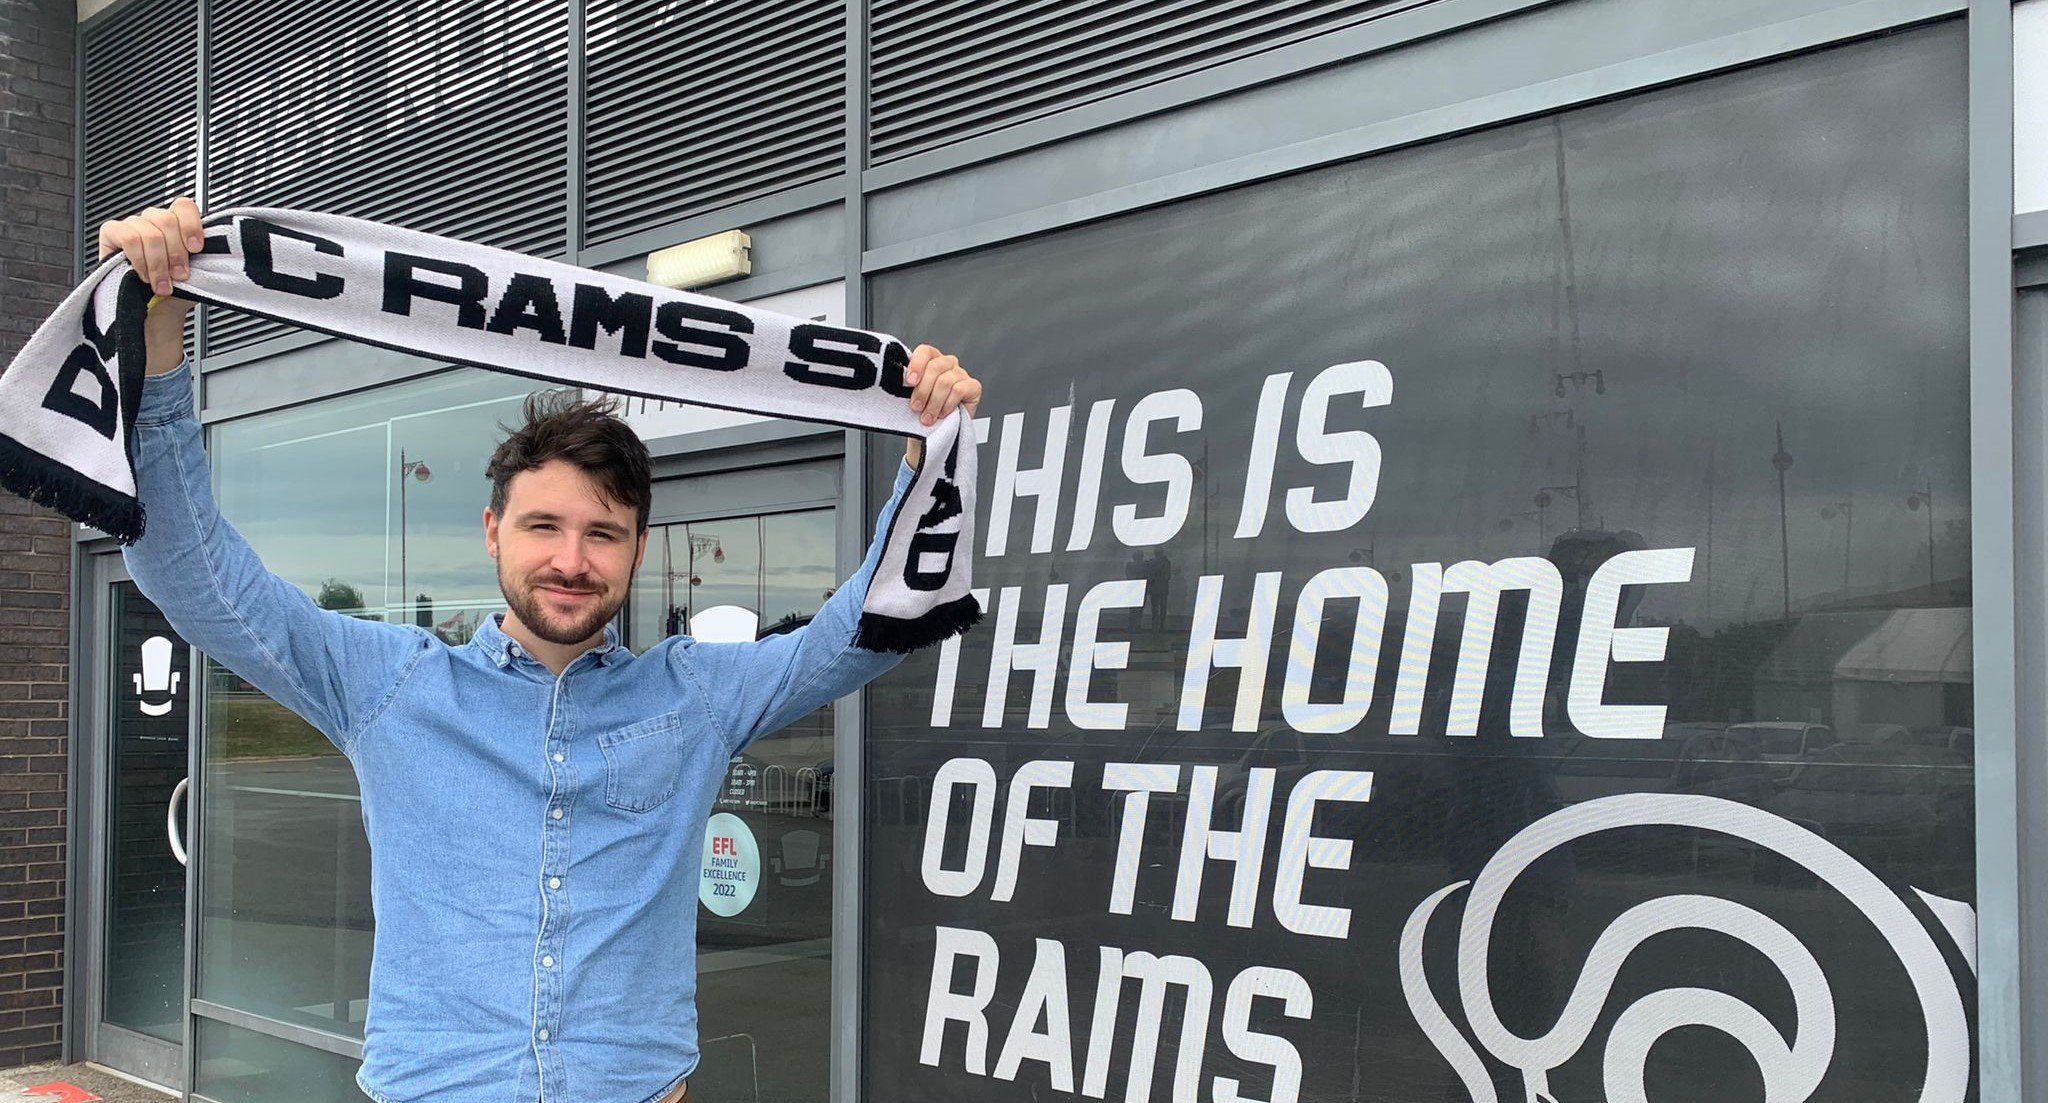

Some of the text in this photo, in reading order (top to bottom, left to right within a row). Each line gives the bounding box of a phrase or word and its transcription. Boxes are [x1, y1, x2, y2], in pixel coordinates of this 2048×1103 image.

[203, 217, 345, 300] C
[381, 250, 755, 372] RAMS
[971, 359, 1394, 557] HIS IS
[1176, 546, 1697, 740] HOME
[703, 868, 747, 882] EXCELLENCE
[711, 857, 739, 869] FAMILY
[712, 836, 738, 856] EFL
[712, 883, 737, 898] 2022
[921, 757, 1374, 940] OF THE
[919, 925, 1314, 1103] RAMS
